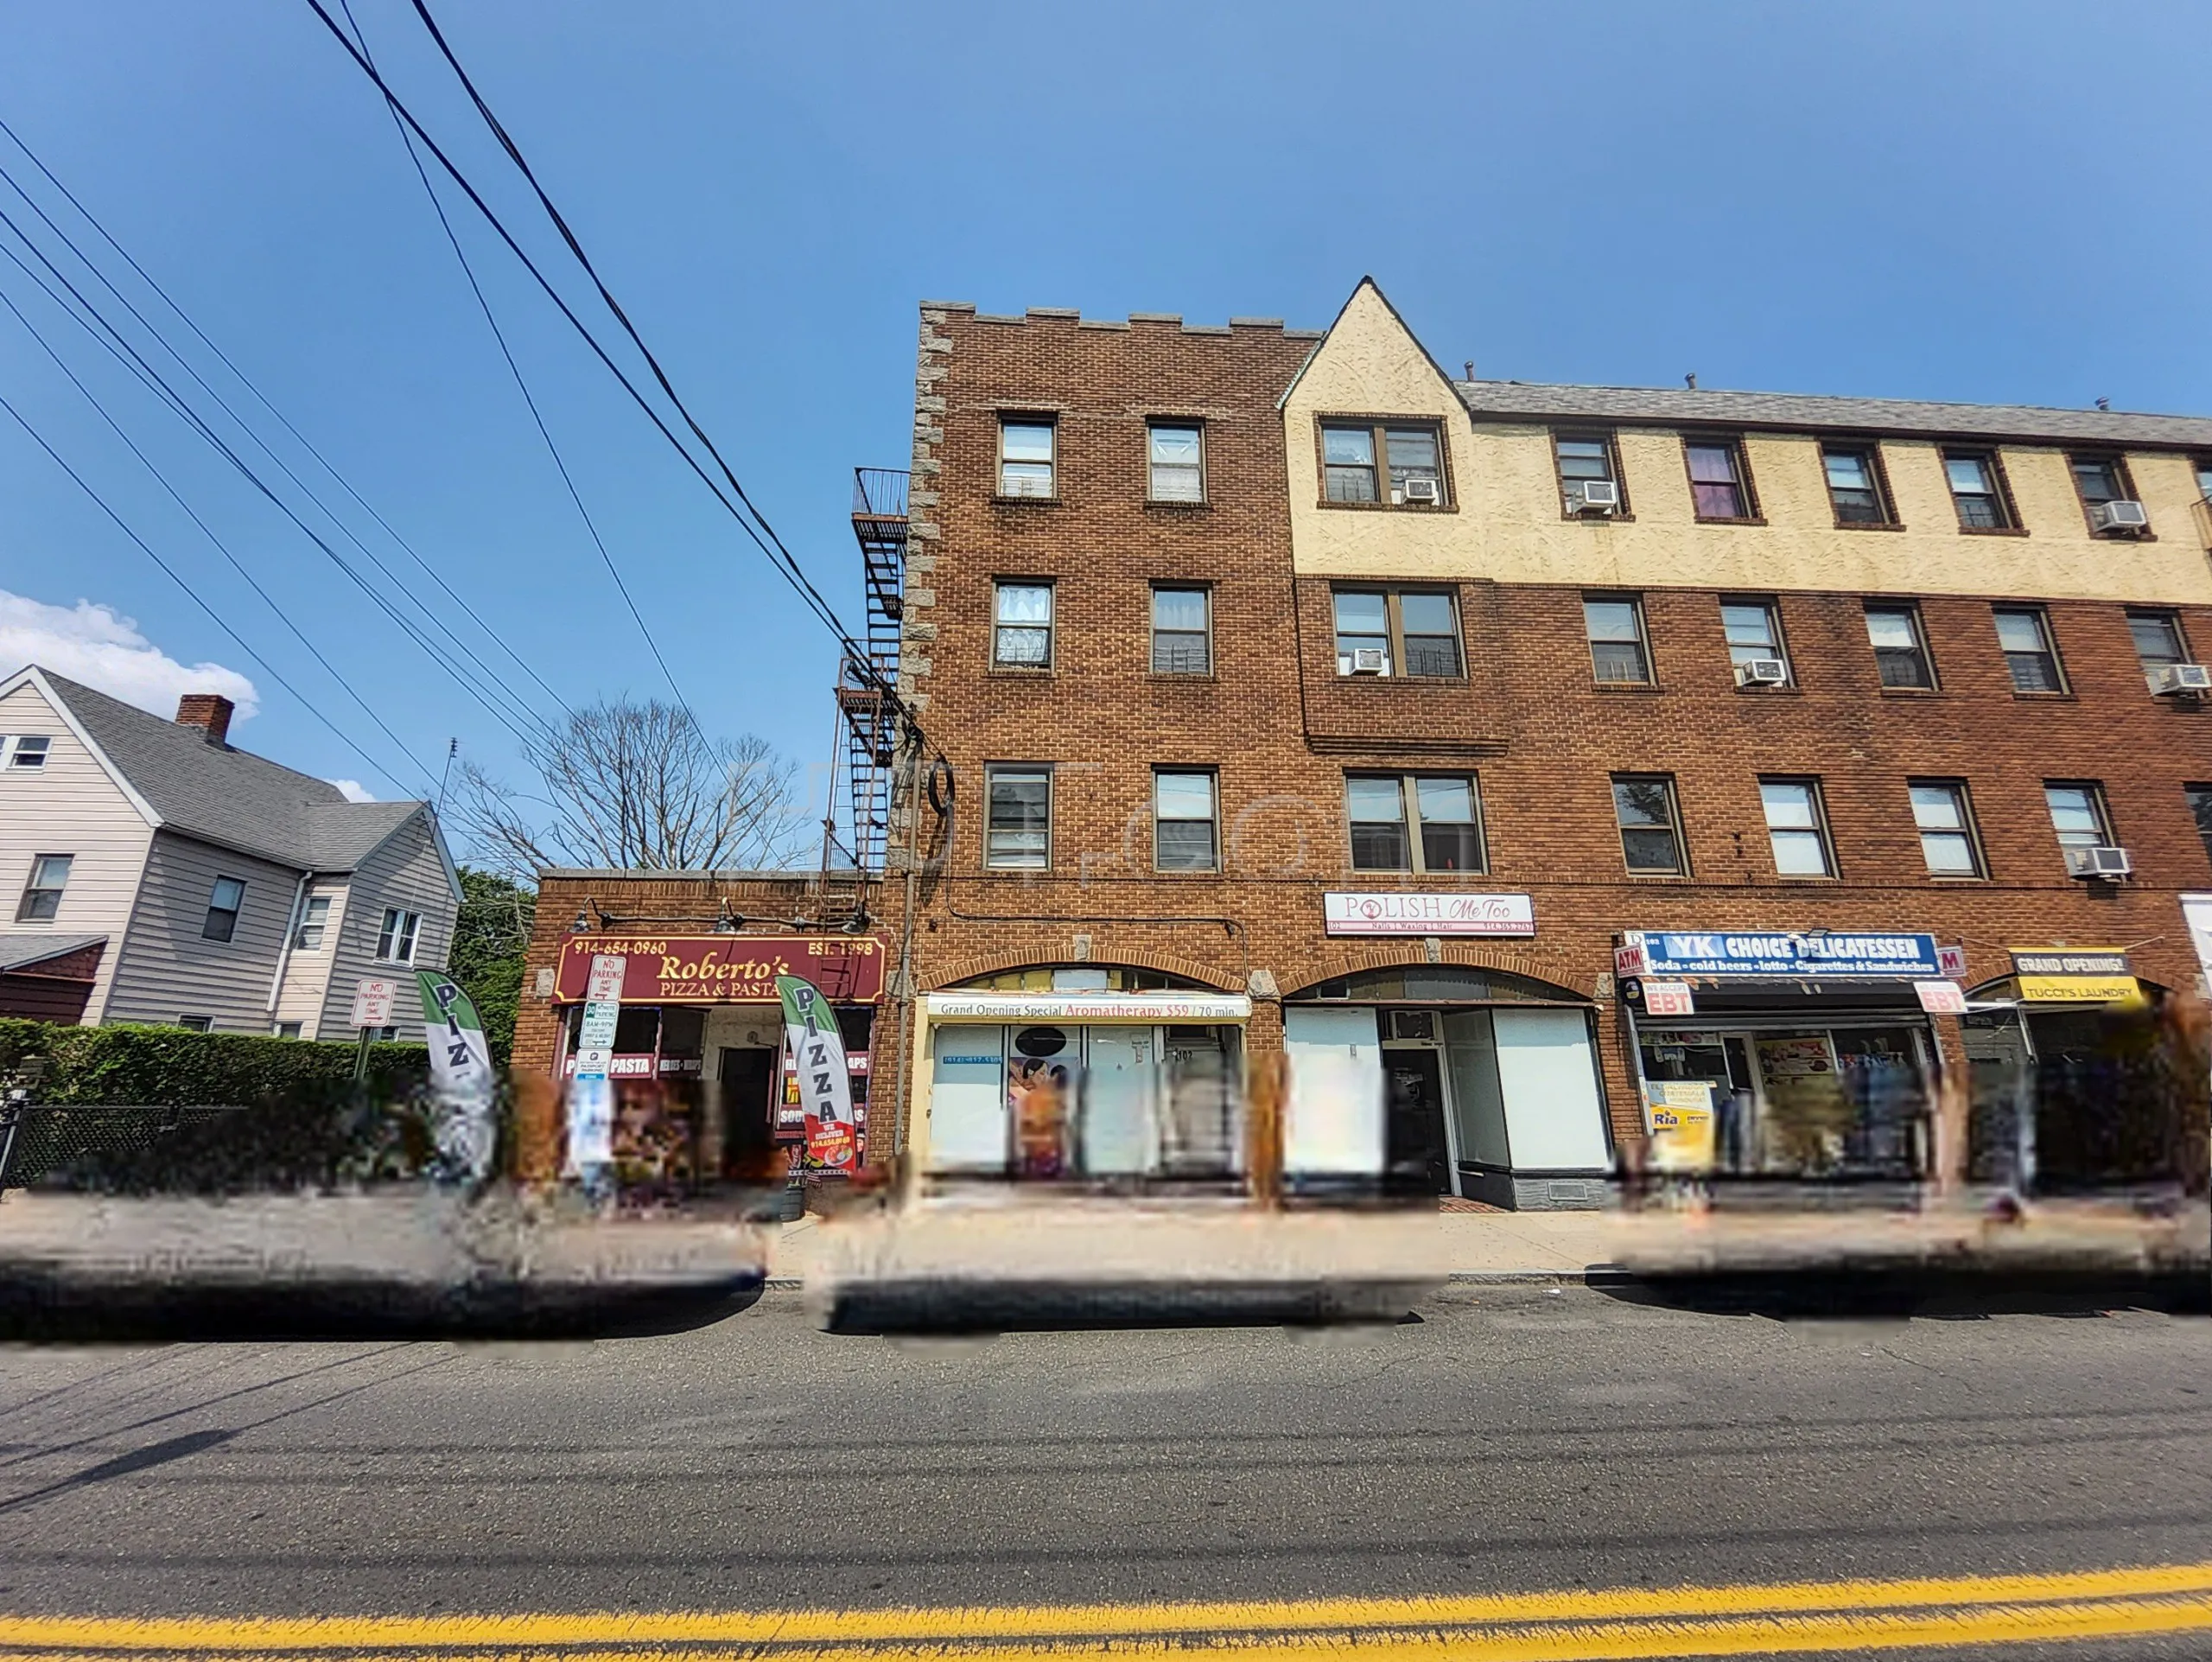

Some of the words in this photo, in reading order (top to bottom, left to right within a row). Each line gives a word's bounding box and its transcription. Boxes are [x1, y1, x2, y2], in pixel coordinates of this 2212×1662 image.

[1344, 897, 1442, 919] POLISH
[1449, 899, 1482, 920] Me
[1482, 899, 1510, 919] Too
[575, 941, 667, 955] 914-654-0960
[808, 942, 835, 955] EST.
[839, 942, 874, 955] 1998
[1671, 936, 1719, 958] YK
[1726, 937, 1794, 958] CHOICE
[1796, 937, 1921, 958] DELICATESSEN
[603, 958, 614, 969] NO
[656, 952, 790, 979] Roberto's
[1618, 949, 1642, 970] ATM
[1651, 959, 1682, 971] Soda
[1689, 960, 1717, 971] cold
[1718, 961, 1753, 971] beers
[1758, 960, 1788, 971] lotto
[1795, 960, 1855, 974] Cigarettes
[1866, 961, 1936, 971] Sandwiches
[2017, 958, 2063, 972] GRAND
[593, 970, 622, 979] PARKING
[370, 984, 384, 993] NO
[660, 982, 710, 997] PIZZA
[713, 982, 728, 997] &
[2076, 988, 2133, 998] LAUNDRY
[1648, 993, 1689, 1013] EBT
[1920, 991, 1962, 1010] EBT
[941, 1003, 973, 1015] Grand
[976, 1004, 1021, 1016] Opening
[1024, 1004, 1062, 1017] Special
[1065, 1003, 1163, 1018] Aromatherapy
[1166, 1004, 1189, 1016] $59
[1199, 1006, 1211, 1016] 70
[794, 985, 838, 1123] PIZZA
[610, 1058, 650, 1073] PASTA
[1654, 1110, 1679, 1125] Ria
